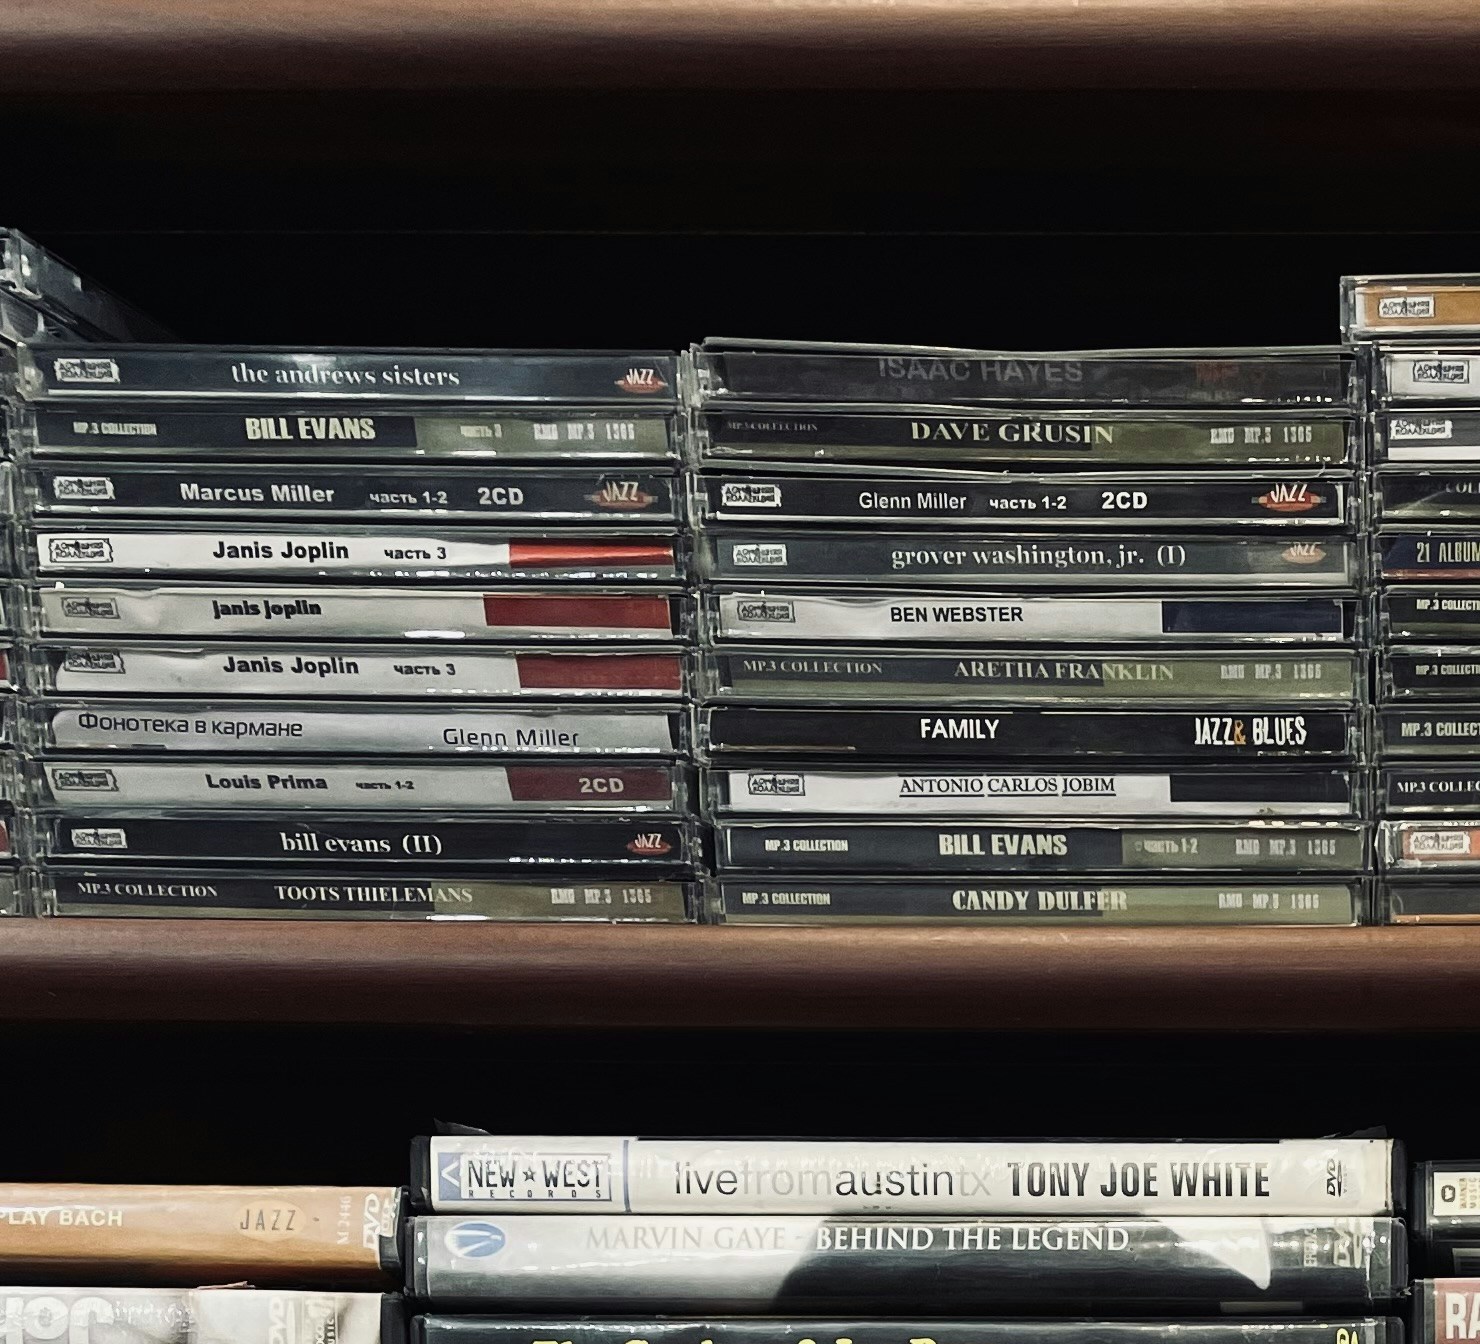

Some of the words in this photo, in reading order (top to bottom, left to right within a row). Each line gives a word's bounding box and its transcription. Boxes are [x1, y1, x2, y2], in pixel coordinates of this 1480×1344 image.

[231, 363, 267, 385] the
[276, 364, 375, 386] andrews
[383, 365, 460, 387] sisters
[180, 483, 262, 503] Marcus
[269, 484, 334, 504] Miller
[370, 491, 415, 505] часть
[422, 491, 447, 505] 1-2
[478, 487, 524, 506] 2CD
[892, 546, 967, 570] grover
[972, 545, 1110, 569] washington,
[1116, 546, 1144, 569] jr.
[1158, 545, 1185, 567] (I)
[891, 606, 927, 623] BEN
[933, 606, 1023, 623] WEBSTER
[78, 713, 189, 734] Фонотека
[195, 720, 207, 734] в
[212, 720, 303, 740] кармане
[443, 728, 508, 746] Glenn
[516, 729, 578, 747] Miller
[900, 777, 983, 794] ANTONIO
[987, 777, 1057, 794] CARLOS
[1062, 776, 1115, 794] JOBIM
